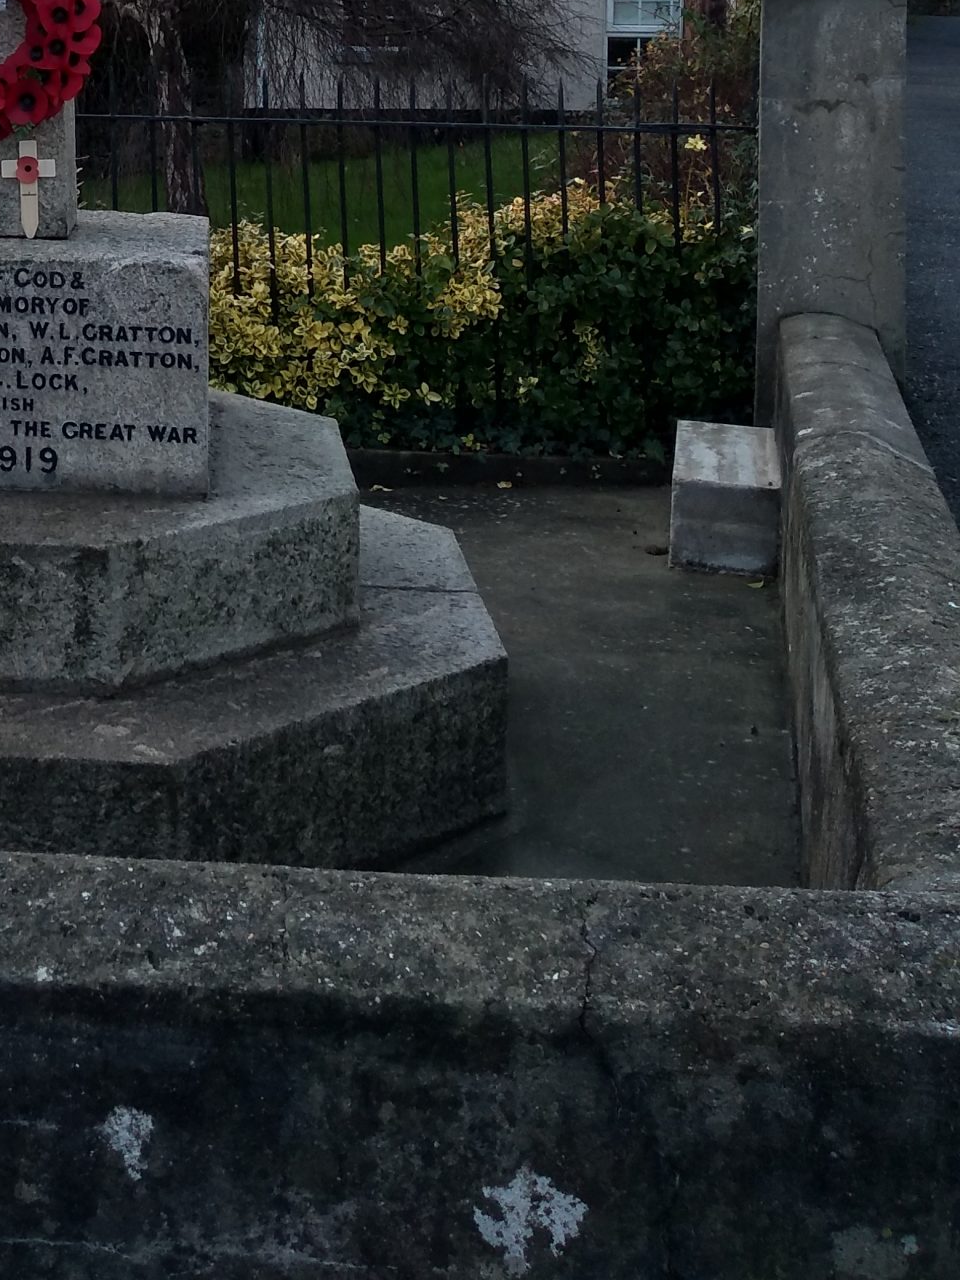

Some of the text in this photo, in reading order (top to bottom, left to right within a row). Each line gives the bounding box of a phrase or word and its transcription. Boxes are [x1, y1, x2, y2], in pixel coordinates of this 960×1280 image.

[71, 272, 85, 289] &
[63, 298, 90, 317] OF
[11, 420, 51, 438] THE
[62, 422, 135, 441] GREAT
[148, 425, 197, 444] WAR
